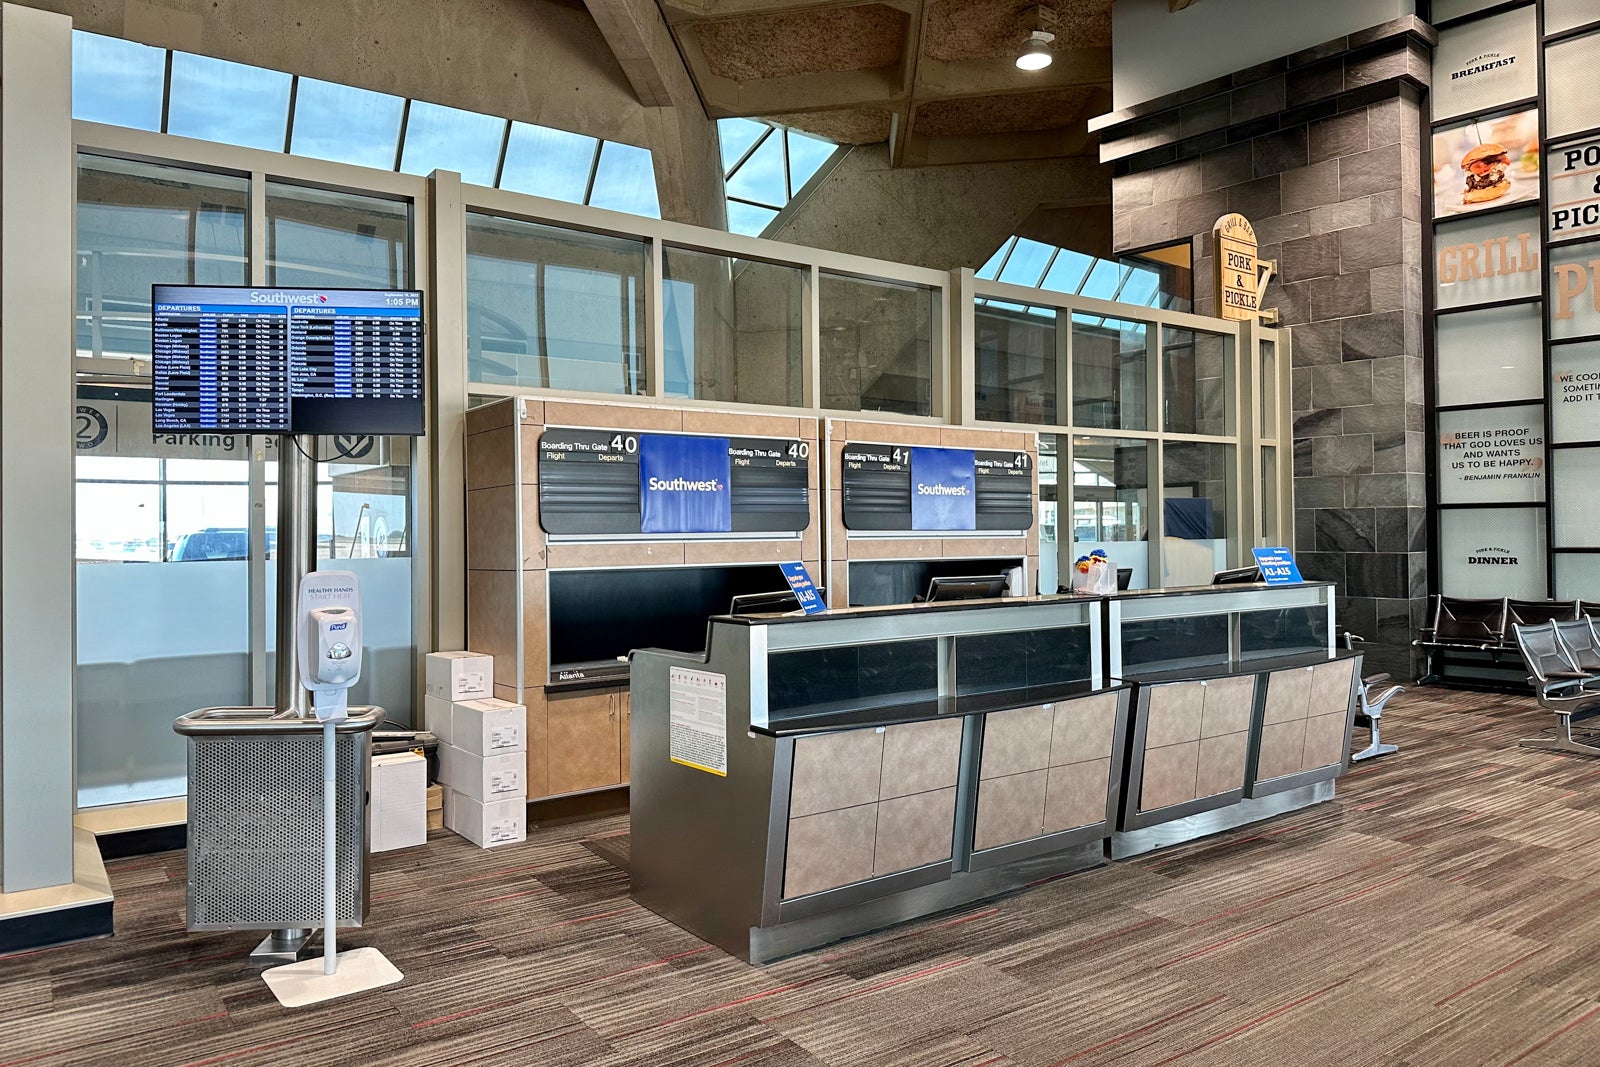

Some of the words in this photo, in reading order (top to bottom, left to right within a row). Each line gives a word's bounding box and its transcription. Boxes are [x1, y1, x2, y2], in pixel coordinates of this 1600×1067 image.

[1451, 56, 1516, 80] BREAKFAST
[1228, 253, 1252, 271] PORK
[1439, 232, 1538, 284] GRILL
[1237, 275, 1244, 288] &
[250, 292, 318, 304] Southwest
[1225, 290, 1256, 309] PICKLE
[1576, 373, 1600, 381] COO
[76, 416, 91, 438] 2
[1495, 428, 1529, 437] PROOF
[541, 442, 572, 451] Boarding
[611, 435, 637, 453] 40
[1494, 438, 1525, 447] LOVES
[547, 452, 565, 460] Flight
[728, 448, 753, 457] Boarding
[788, 443, 809, 458] 40
[845, 454, 866, 462] Boarding
[893, 448, 909, 464] 41
[1486, 449, 1520, 457] WANTS
[1015, 454, 1027, 467] 41
[649, 477, 716, 491] Southwest
[918, 483, 965, 496] Southwest
[1264, 567, 1292, 576] A1-A15
